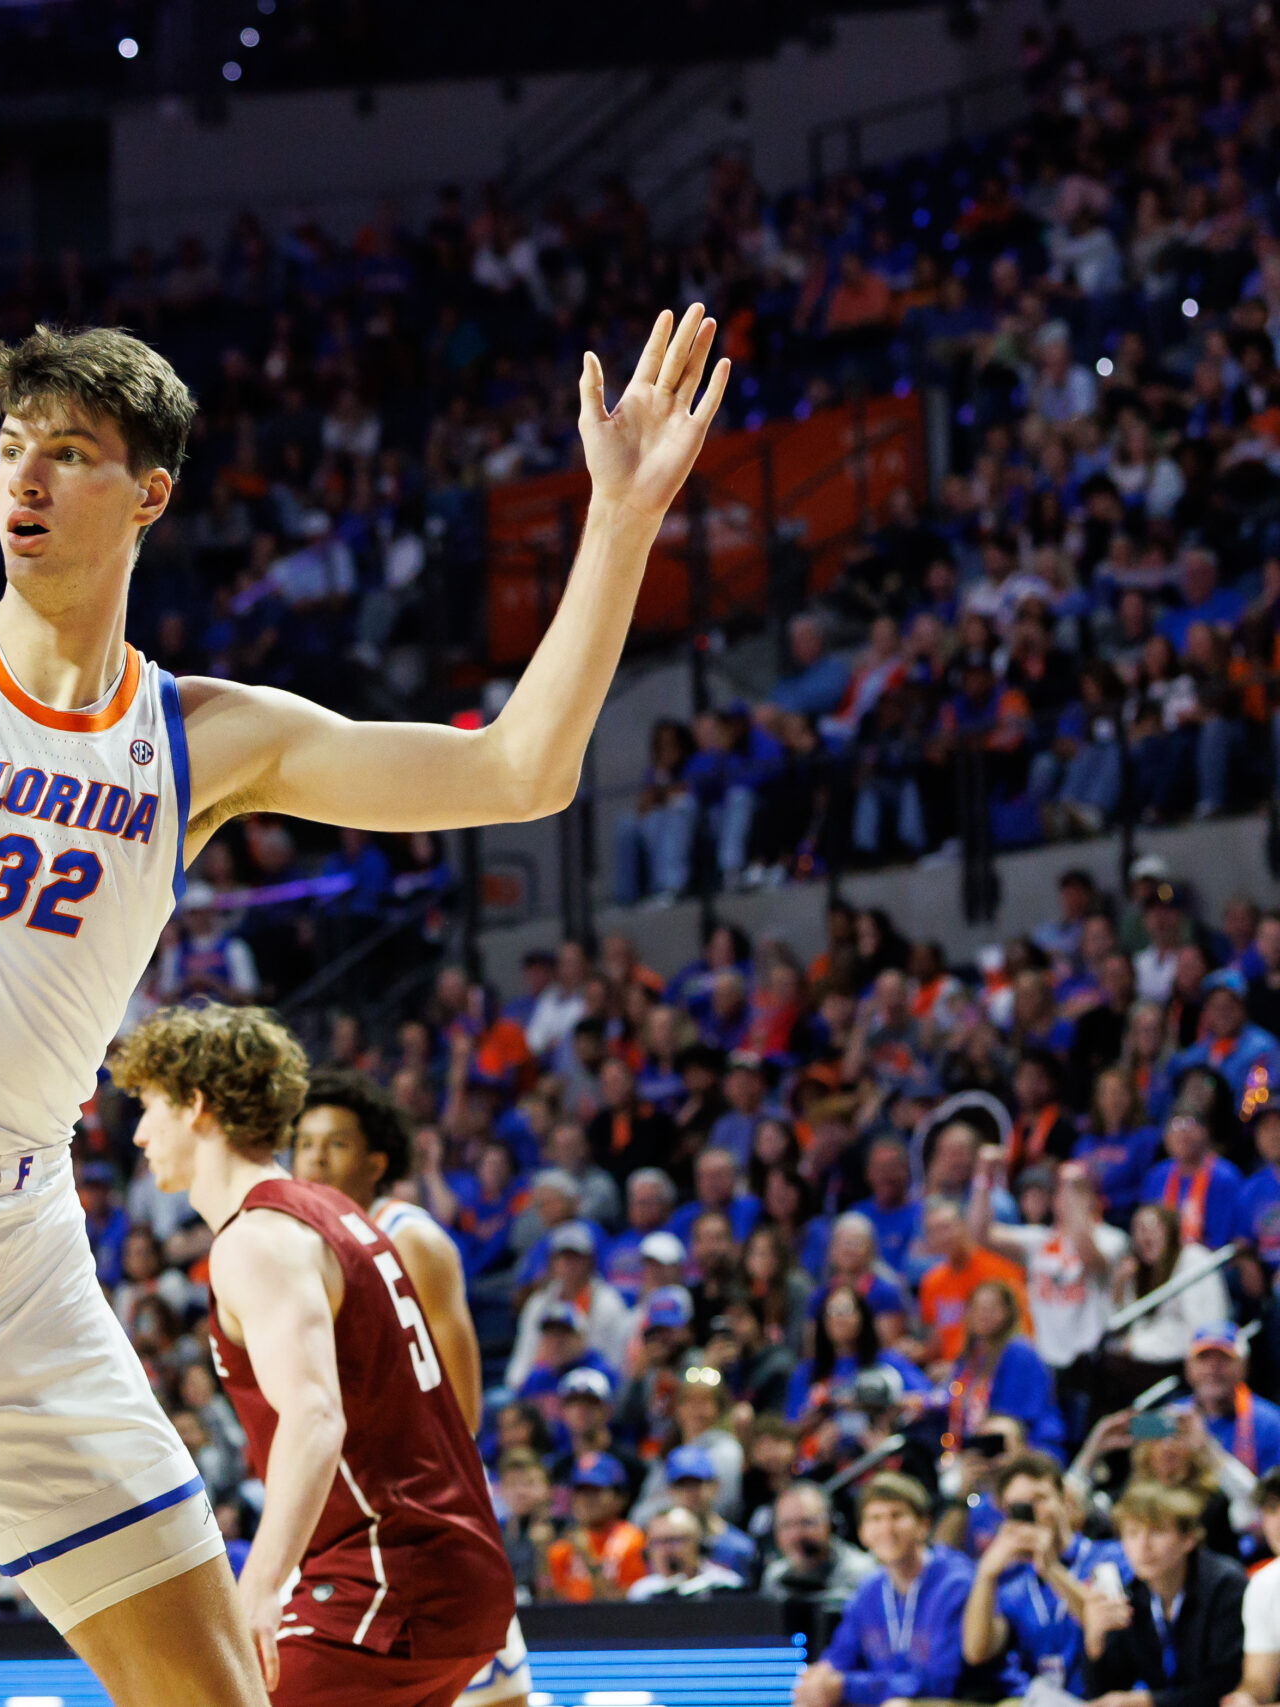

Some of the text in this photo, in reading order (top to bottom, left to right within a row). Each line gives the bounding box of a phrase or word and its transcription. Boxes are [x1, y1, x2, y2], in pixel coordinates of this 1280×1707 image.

[130, 740, 154, 765] SEC
[12, 1154, 34, 1191] F
[372, 1250, 442, 1393] 5
